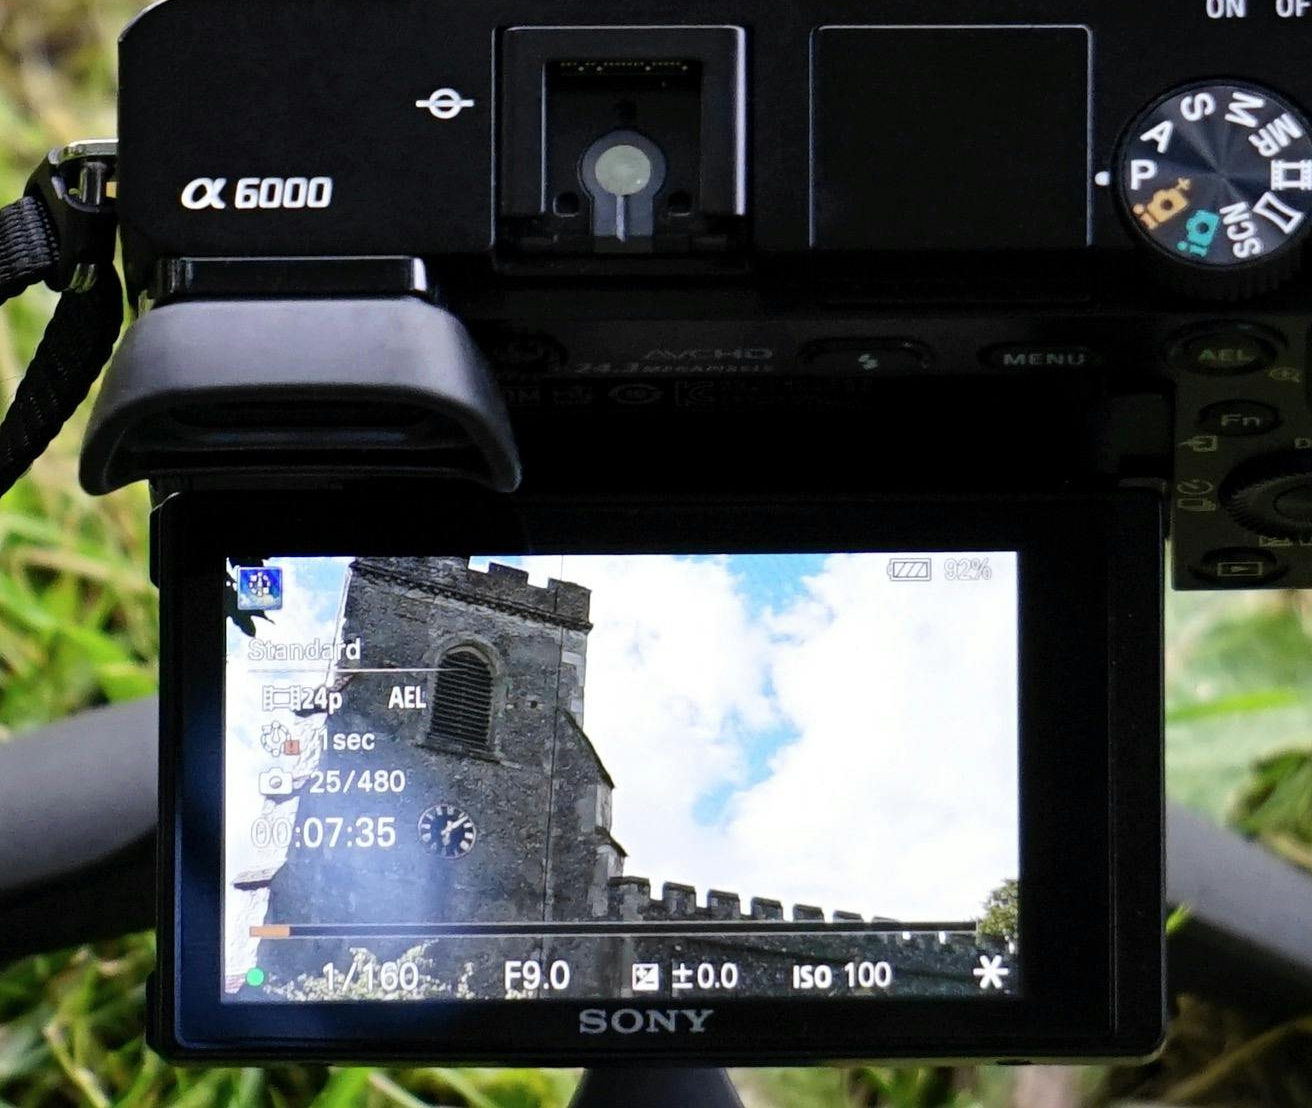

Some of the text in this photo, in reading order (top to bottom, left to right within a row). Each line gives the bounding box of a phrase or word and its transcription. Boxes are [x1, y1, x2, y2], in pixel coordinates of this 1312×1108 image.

[1180, 92, 1216, 122] S
[1224, 91, 1265, 129] M
[1139, 119, 1174, 154] A
[1248, 112, 1304, 158] MR
[1130, 158, 1158, 191] P
[1219, 201, 1264, 259] SCN
[1002, 353, 1088, 366] MENU
[1198, 348, 1256, 362] AEL
[1221, 414, 1260, 427] Fn
[247, 637, 361, 661] Standard
[388, 685, 427, 709] AEL
[309, 769, 407, 794] 25/480
[250, 816, 396, 848] 00:07:35
[322, 961, 420, 992] 1/160
[503, 959, 571, 991] F9.0
[792, 964, 832, 989] ISO
[844, 961, 892, 988] 100
[578, 1007, 714, 1034] SONY
